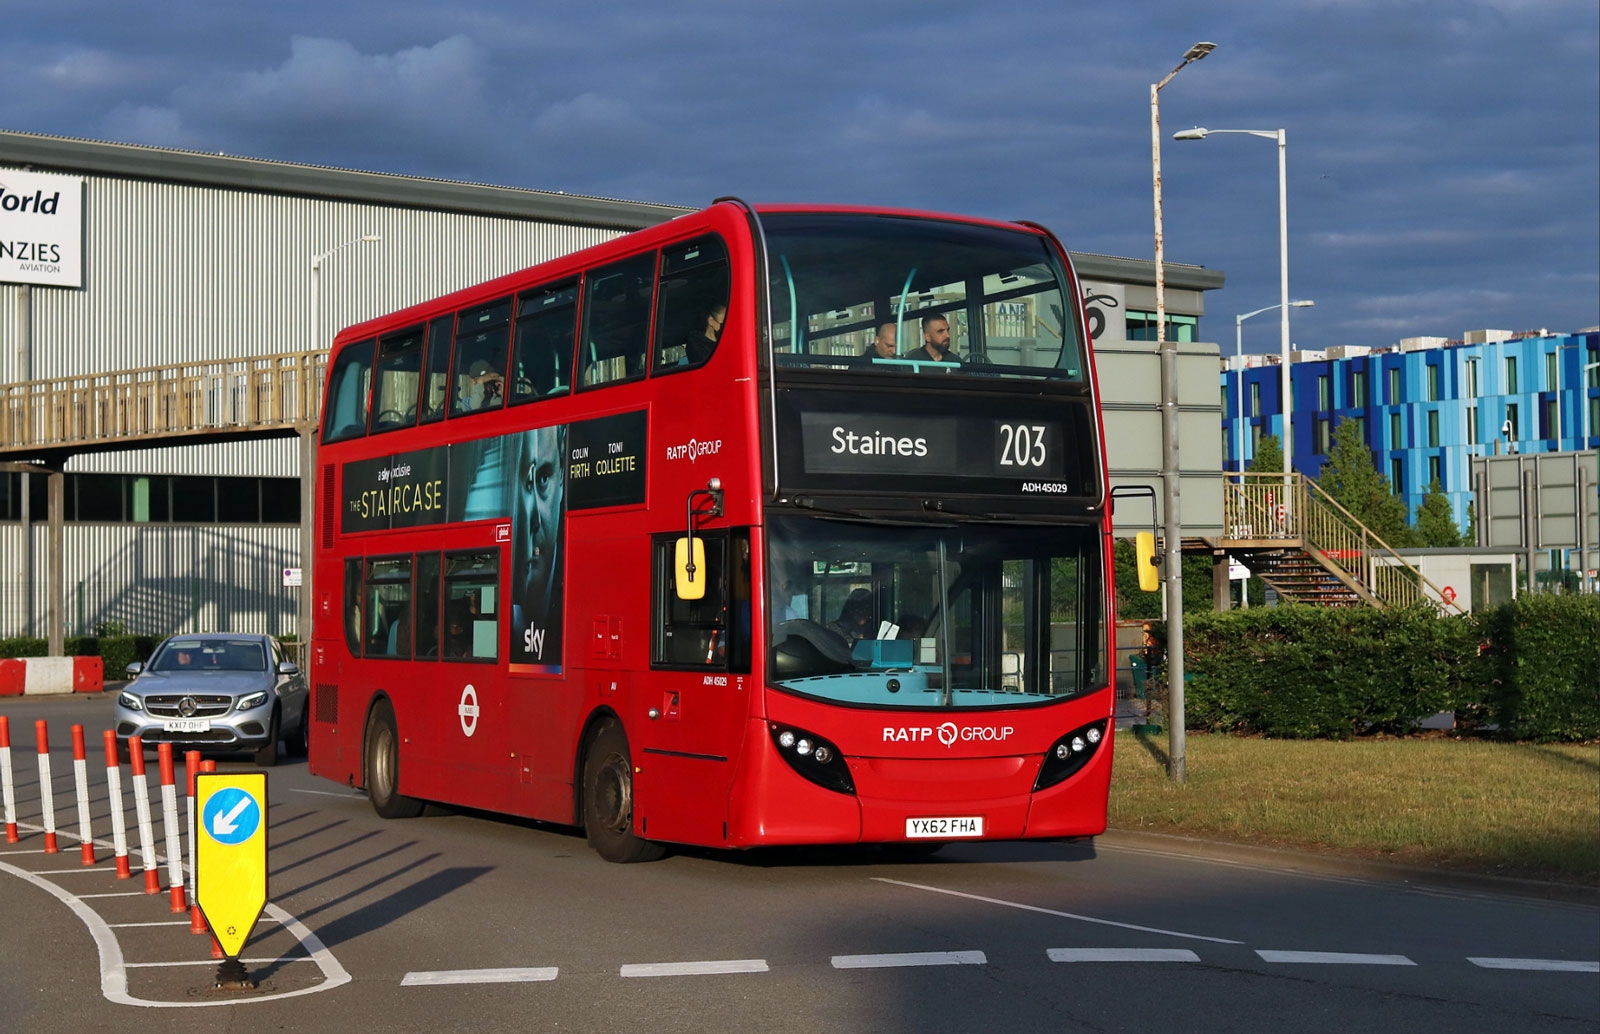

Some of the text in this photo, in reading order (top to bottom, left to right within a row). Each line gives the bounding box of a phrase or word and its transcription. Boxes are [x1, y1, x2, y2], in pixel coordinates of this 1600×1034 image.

[19, 264, 60, 273] AVIATION
[608, 441, 623, 454] TONI
[666, 440, 722, 460] RATP GROUP
[830, 426, 927, 457] Staines
[999, 424, 1047, 467] 203
[571, 448, 589, 460] COLIN
[570, 456, 636, 479] FIRTH COLLETTE
[350, 480, 442, 518] THE STAIRCASE
[524, 621, 545, 661] sky
[883, 727, 1014, 742] RATP GROUP
[912, 819, 976, 833] YX62 FHA
